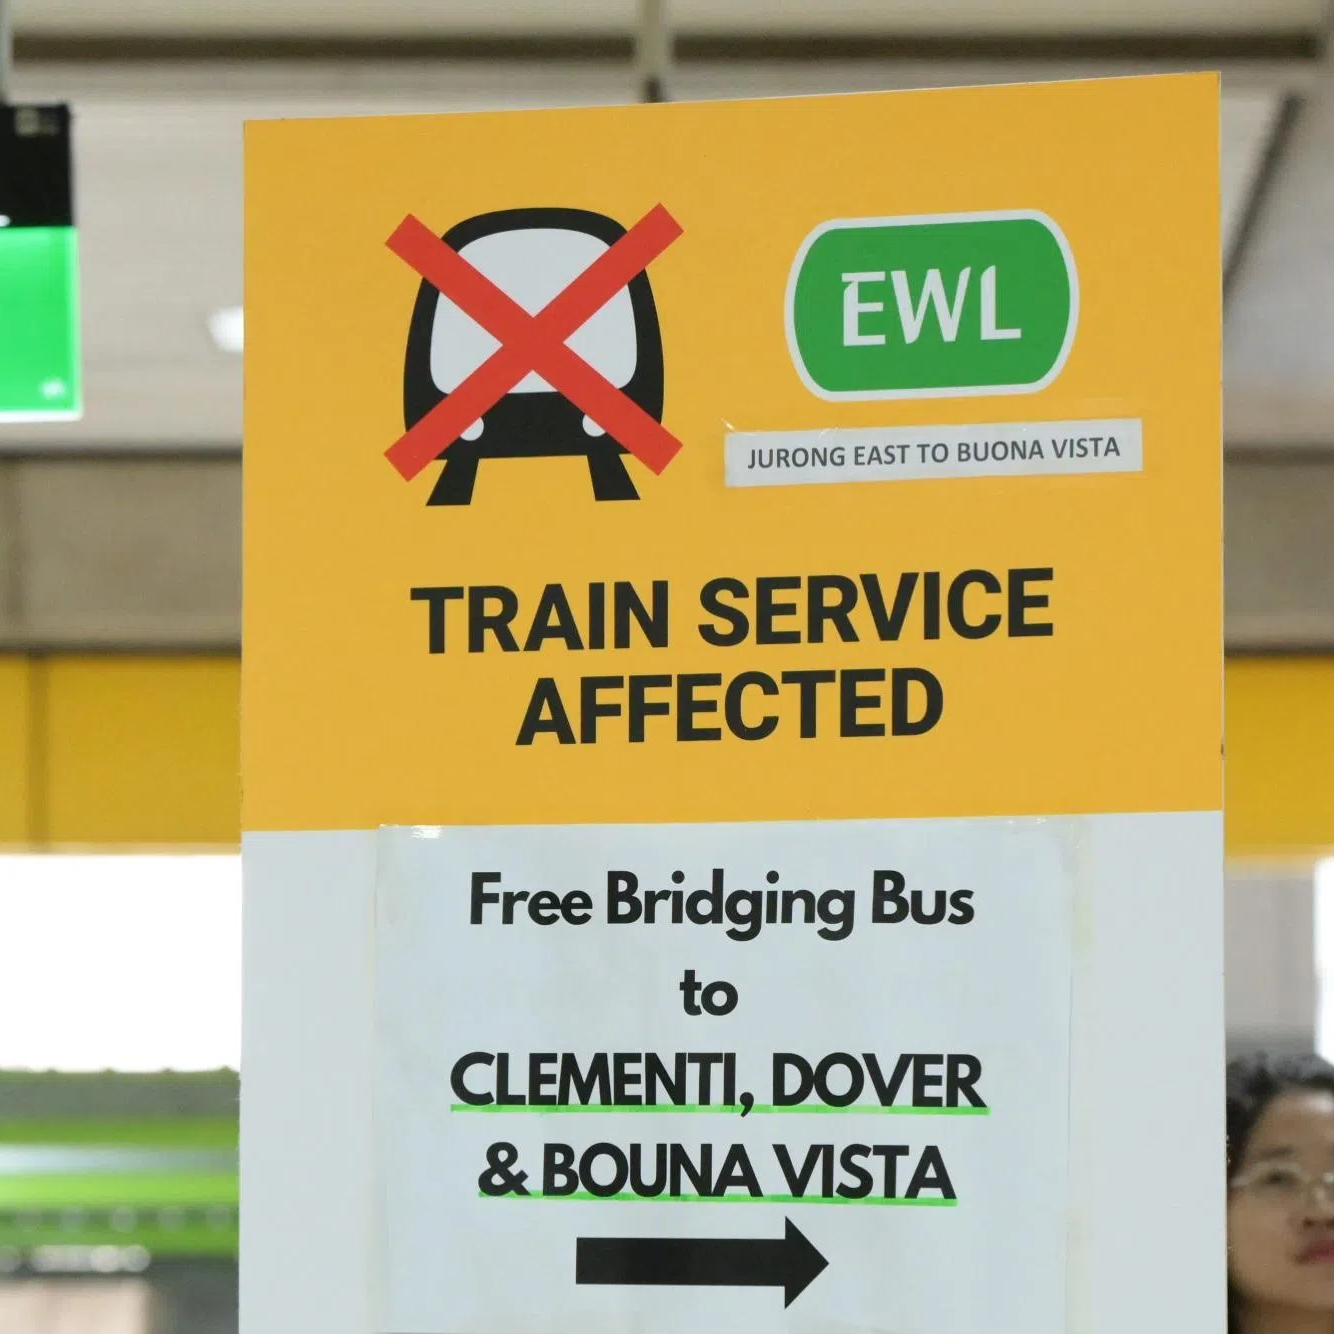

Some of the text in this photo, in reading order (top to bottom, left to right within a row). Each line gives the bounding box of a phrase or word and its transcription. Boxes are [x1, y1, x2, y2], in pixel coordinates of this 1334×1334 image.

[841, 265, 1022, 347] EWL
[747, 436, 1121, 469] JURONG EAST TO BUONA VISTA
[409, 567, 1054, 655] TRAIN SERVICE
[515, 667, 944, 746] AFFECTED
[470, 868, 975, 942] Free Bridging Bus
[679, 969, 739, 1017] to
[450, 1051, 988, 1118] CLEMENTI, DOVER
[477, 1141, 957, 1200] & BOUNA VISTA
